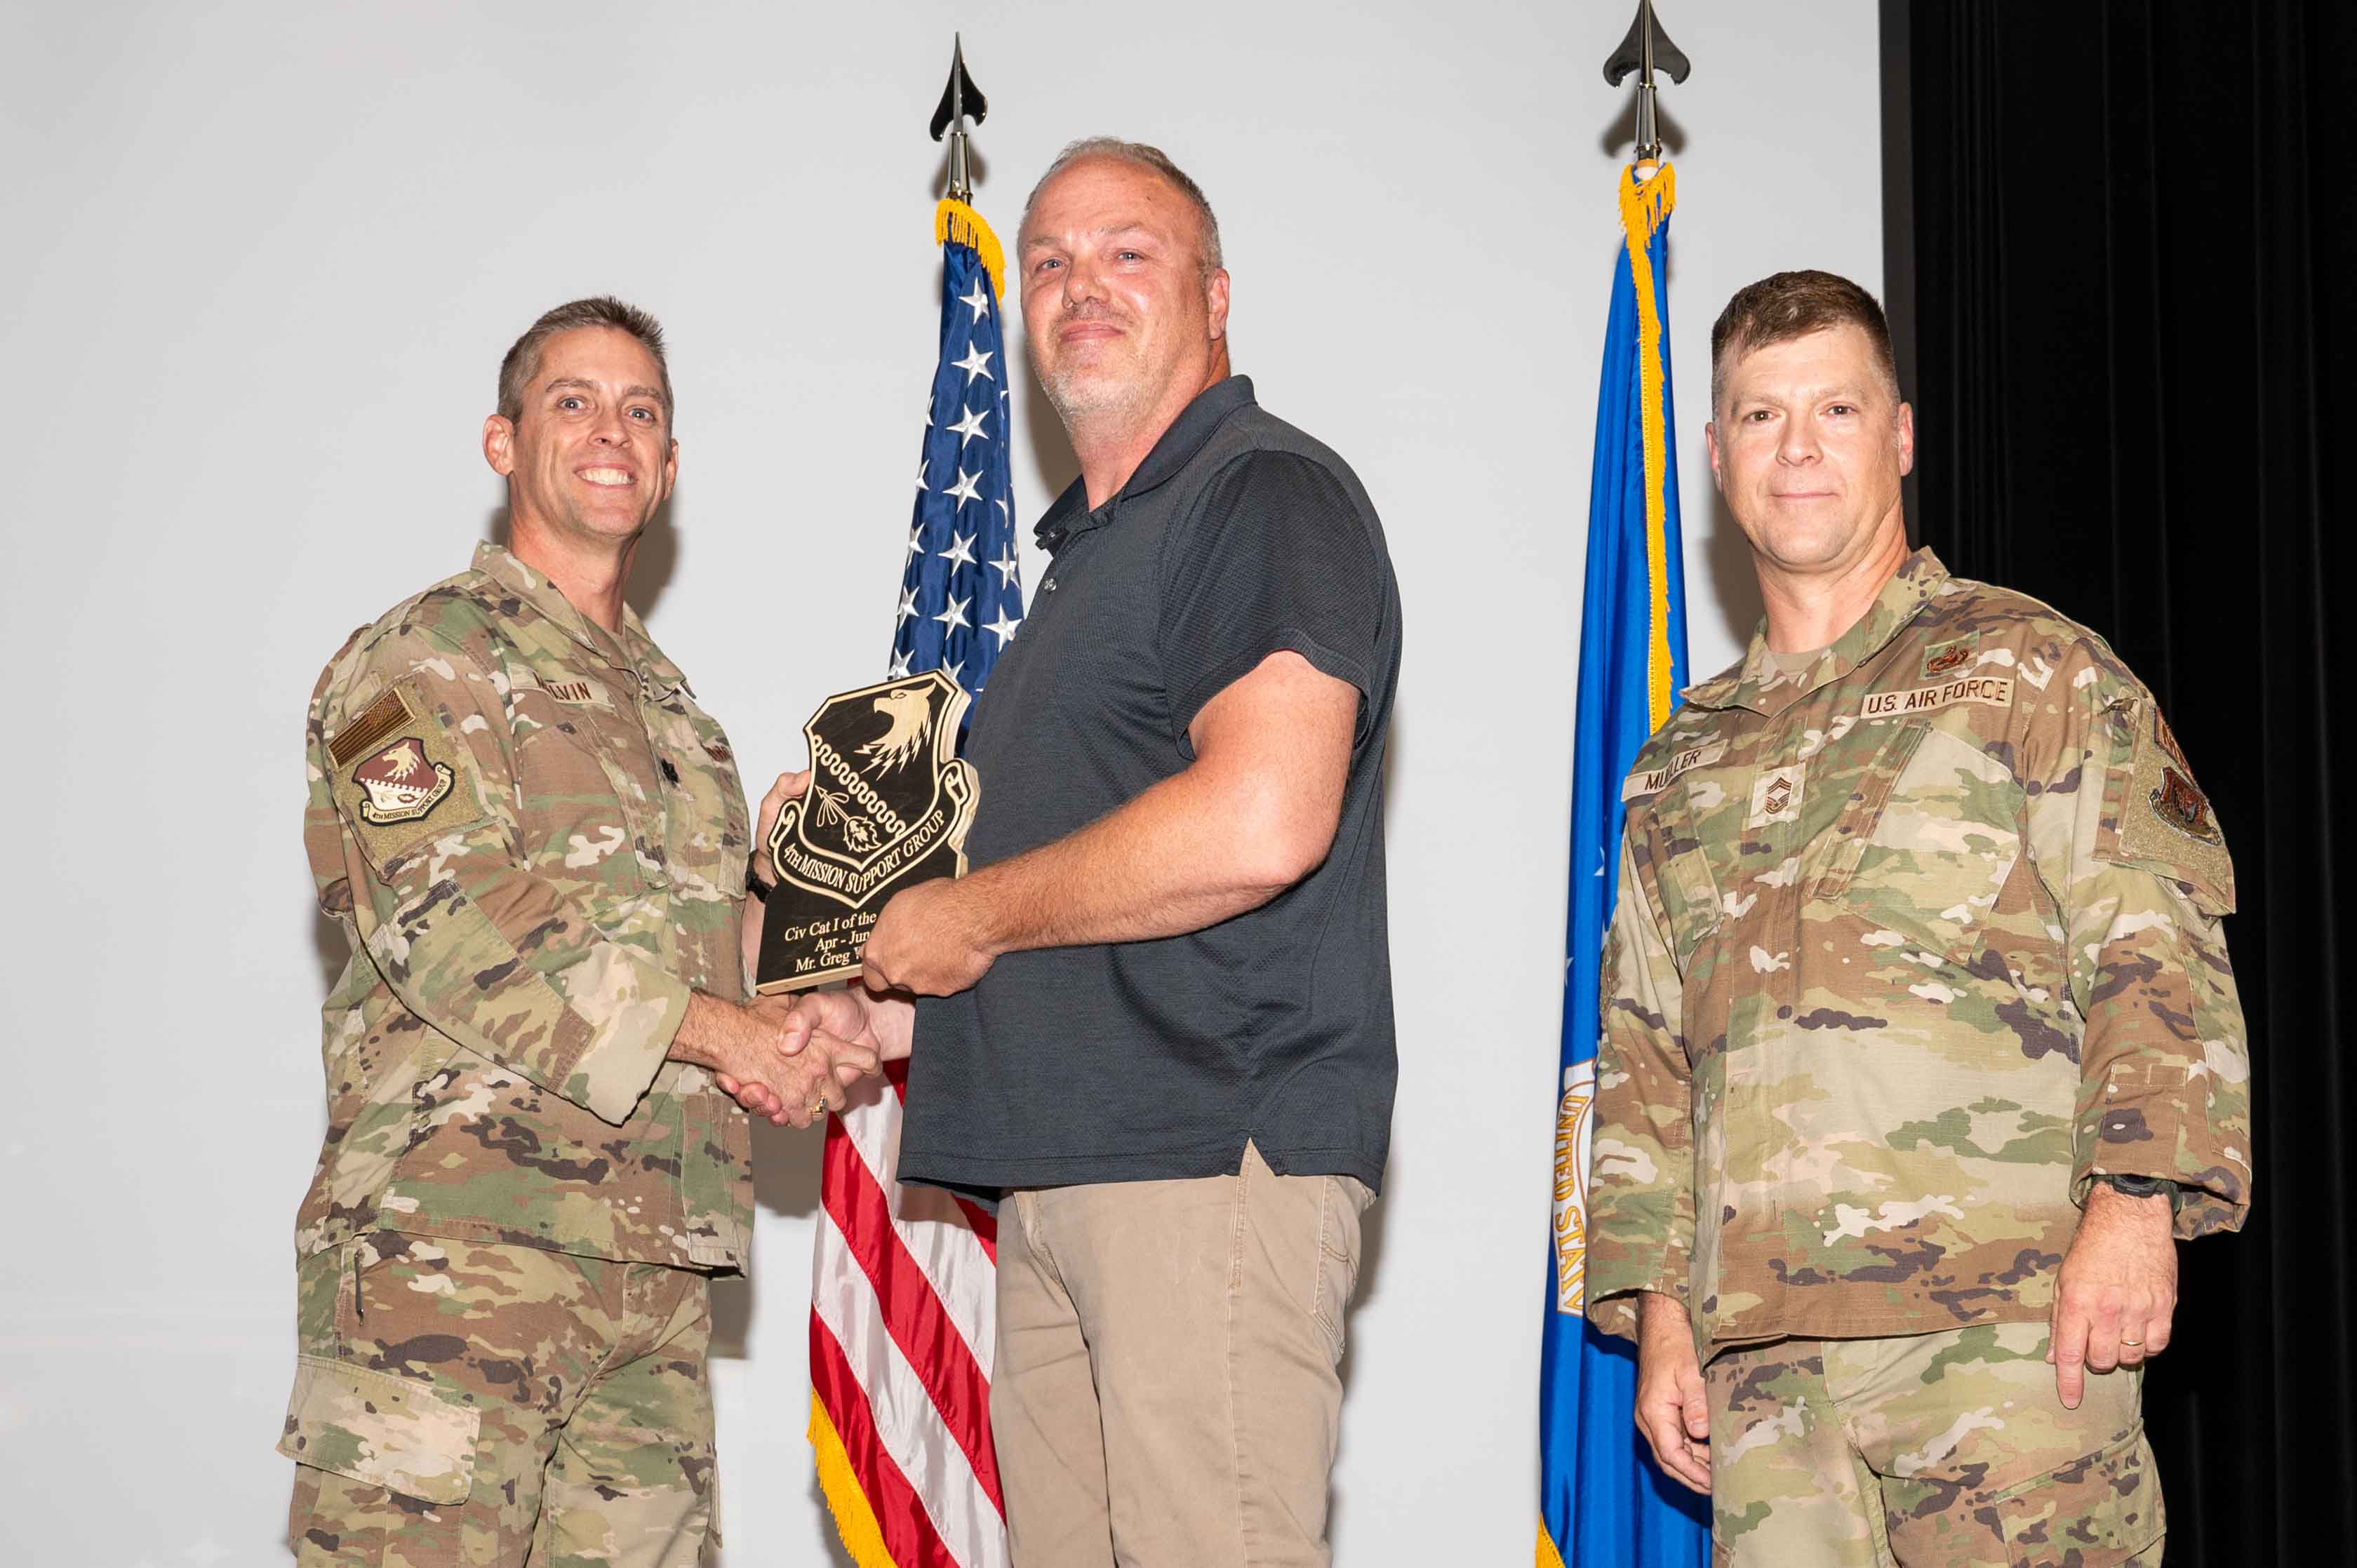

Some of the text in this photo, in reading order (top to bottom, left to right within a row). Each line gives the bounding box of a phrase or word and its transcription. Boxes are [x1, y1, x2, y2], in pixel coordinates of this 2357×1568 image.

[1868, 680, 2008, 713] U.S. AIR FORCE
[383, 810, 410, 819] MISSION
[412, 797, 432, 815] SUPPORT
[432, 779, 446, 796] GROUP
[784, 810, 945, 894] 4TH MISSION SUPPORT GROUP
[784, 911, 877, 942] Civ Cat I of the
[794, 956, 816, 972] Mr.
[820, 951, 850, 966] Greg
[814, 937, 838, 953] Apr
[1554, 1094, 1589, 1202] UNITED
